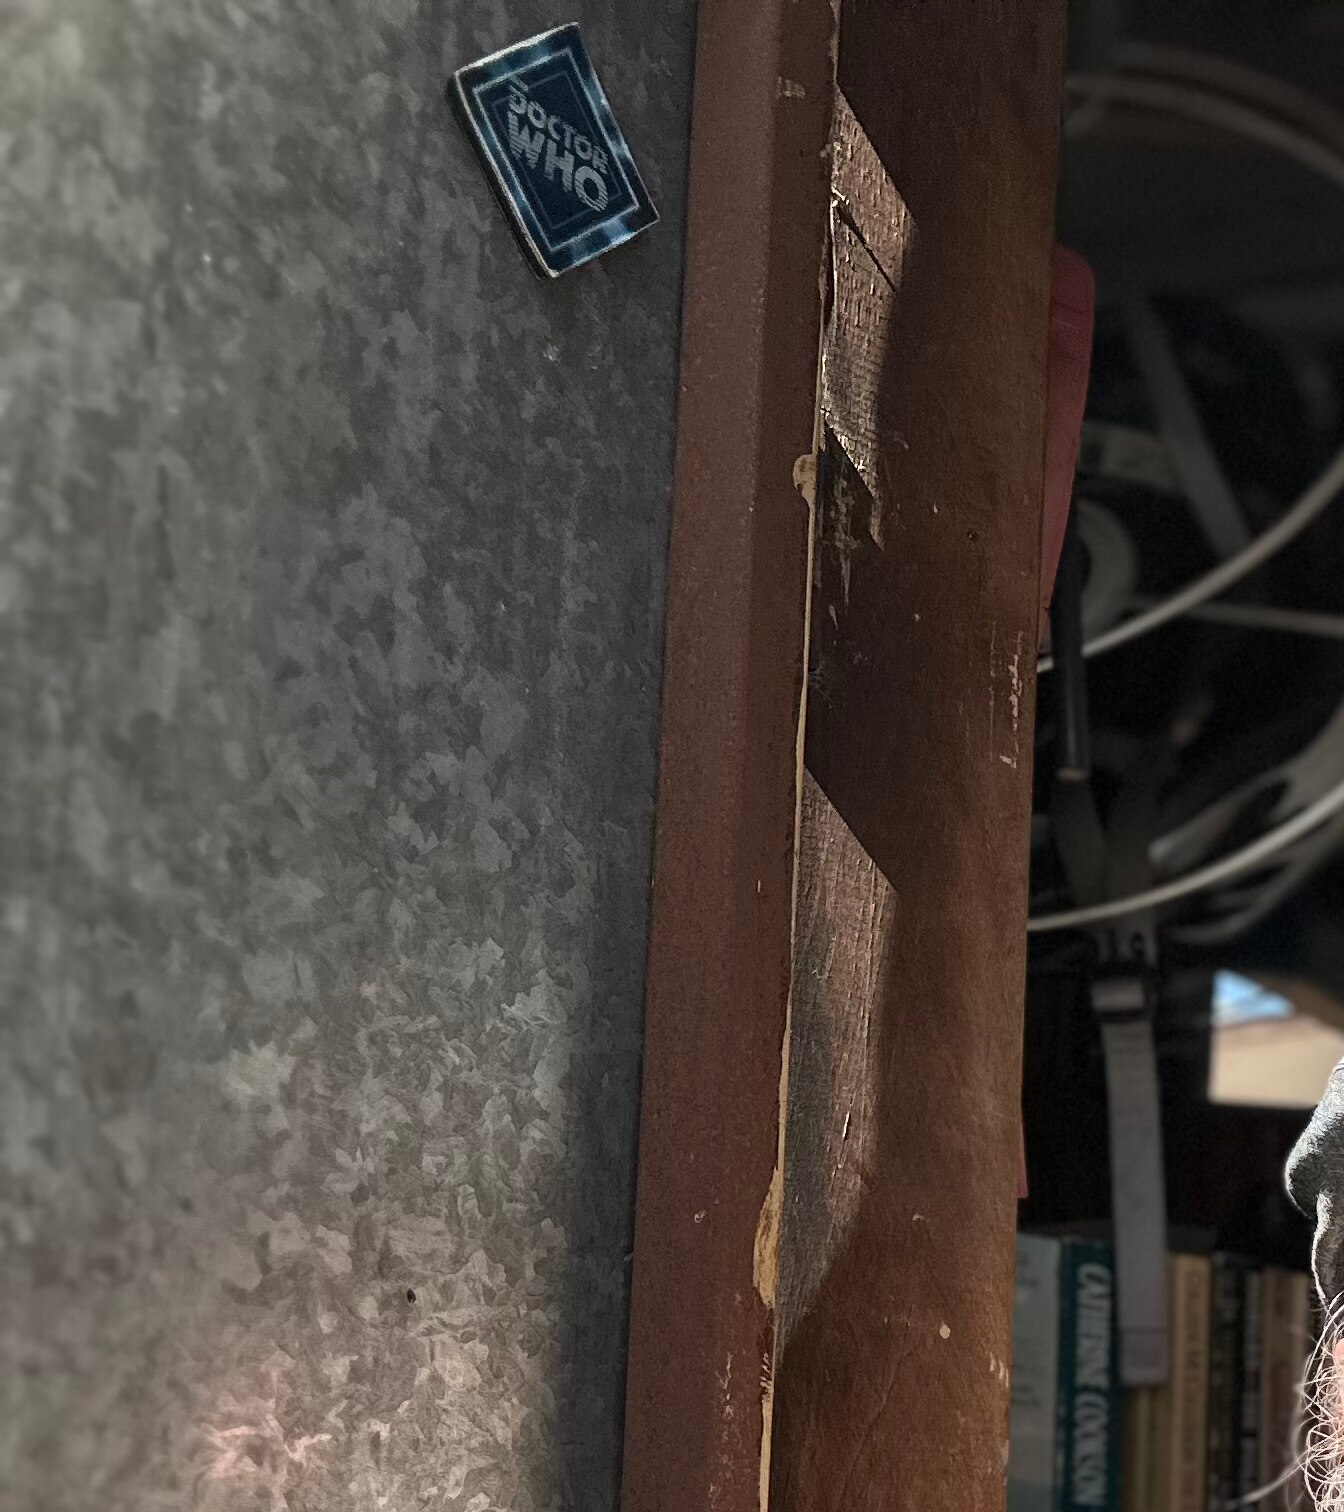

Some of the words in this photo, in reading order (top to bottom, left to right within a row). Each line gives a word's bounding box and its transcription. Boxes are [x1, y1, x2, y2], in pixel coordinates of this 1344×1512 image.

[507, 111, 609, 213] WHO
[508, 76, 609, 175] DOCTOR
[1075, 1263, 1112, 1390] CATHERINE
[1072, 1392, 1109, 1506] COOKSON
